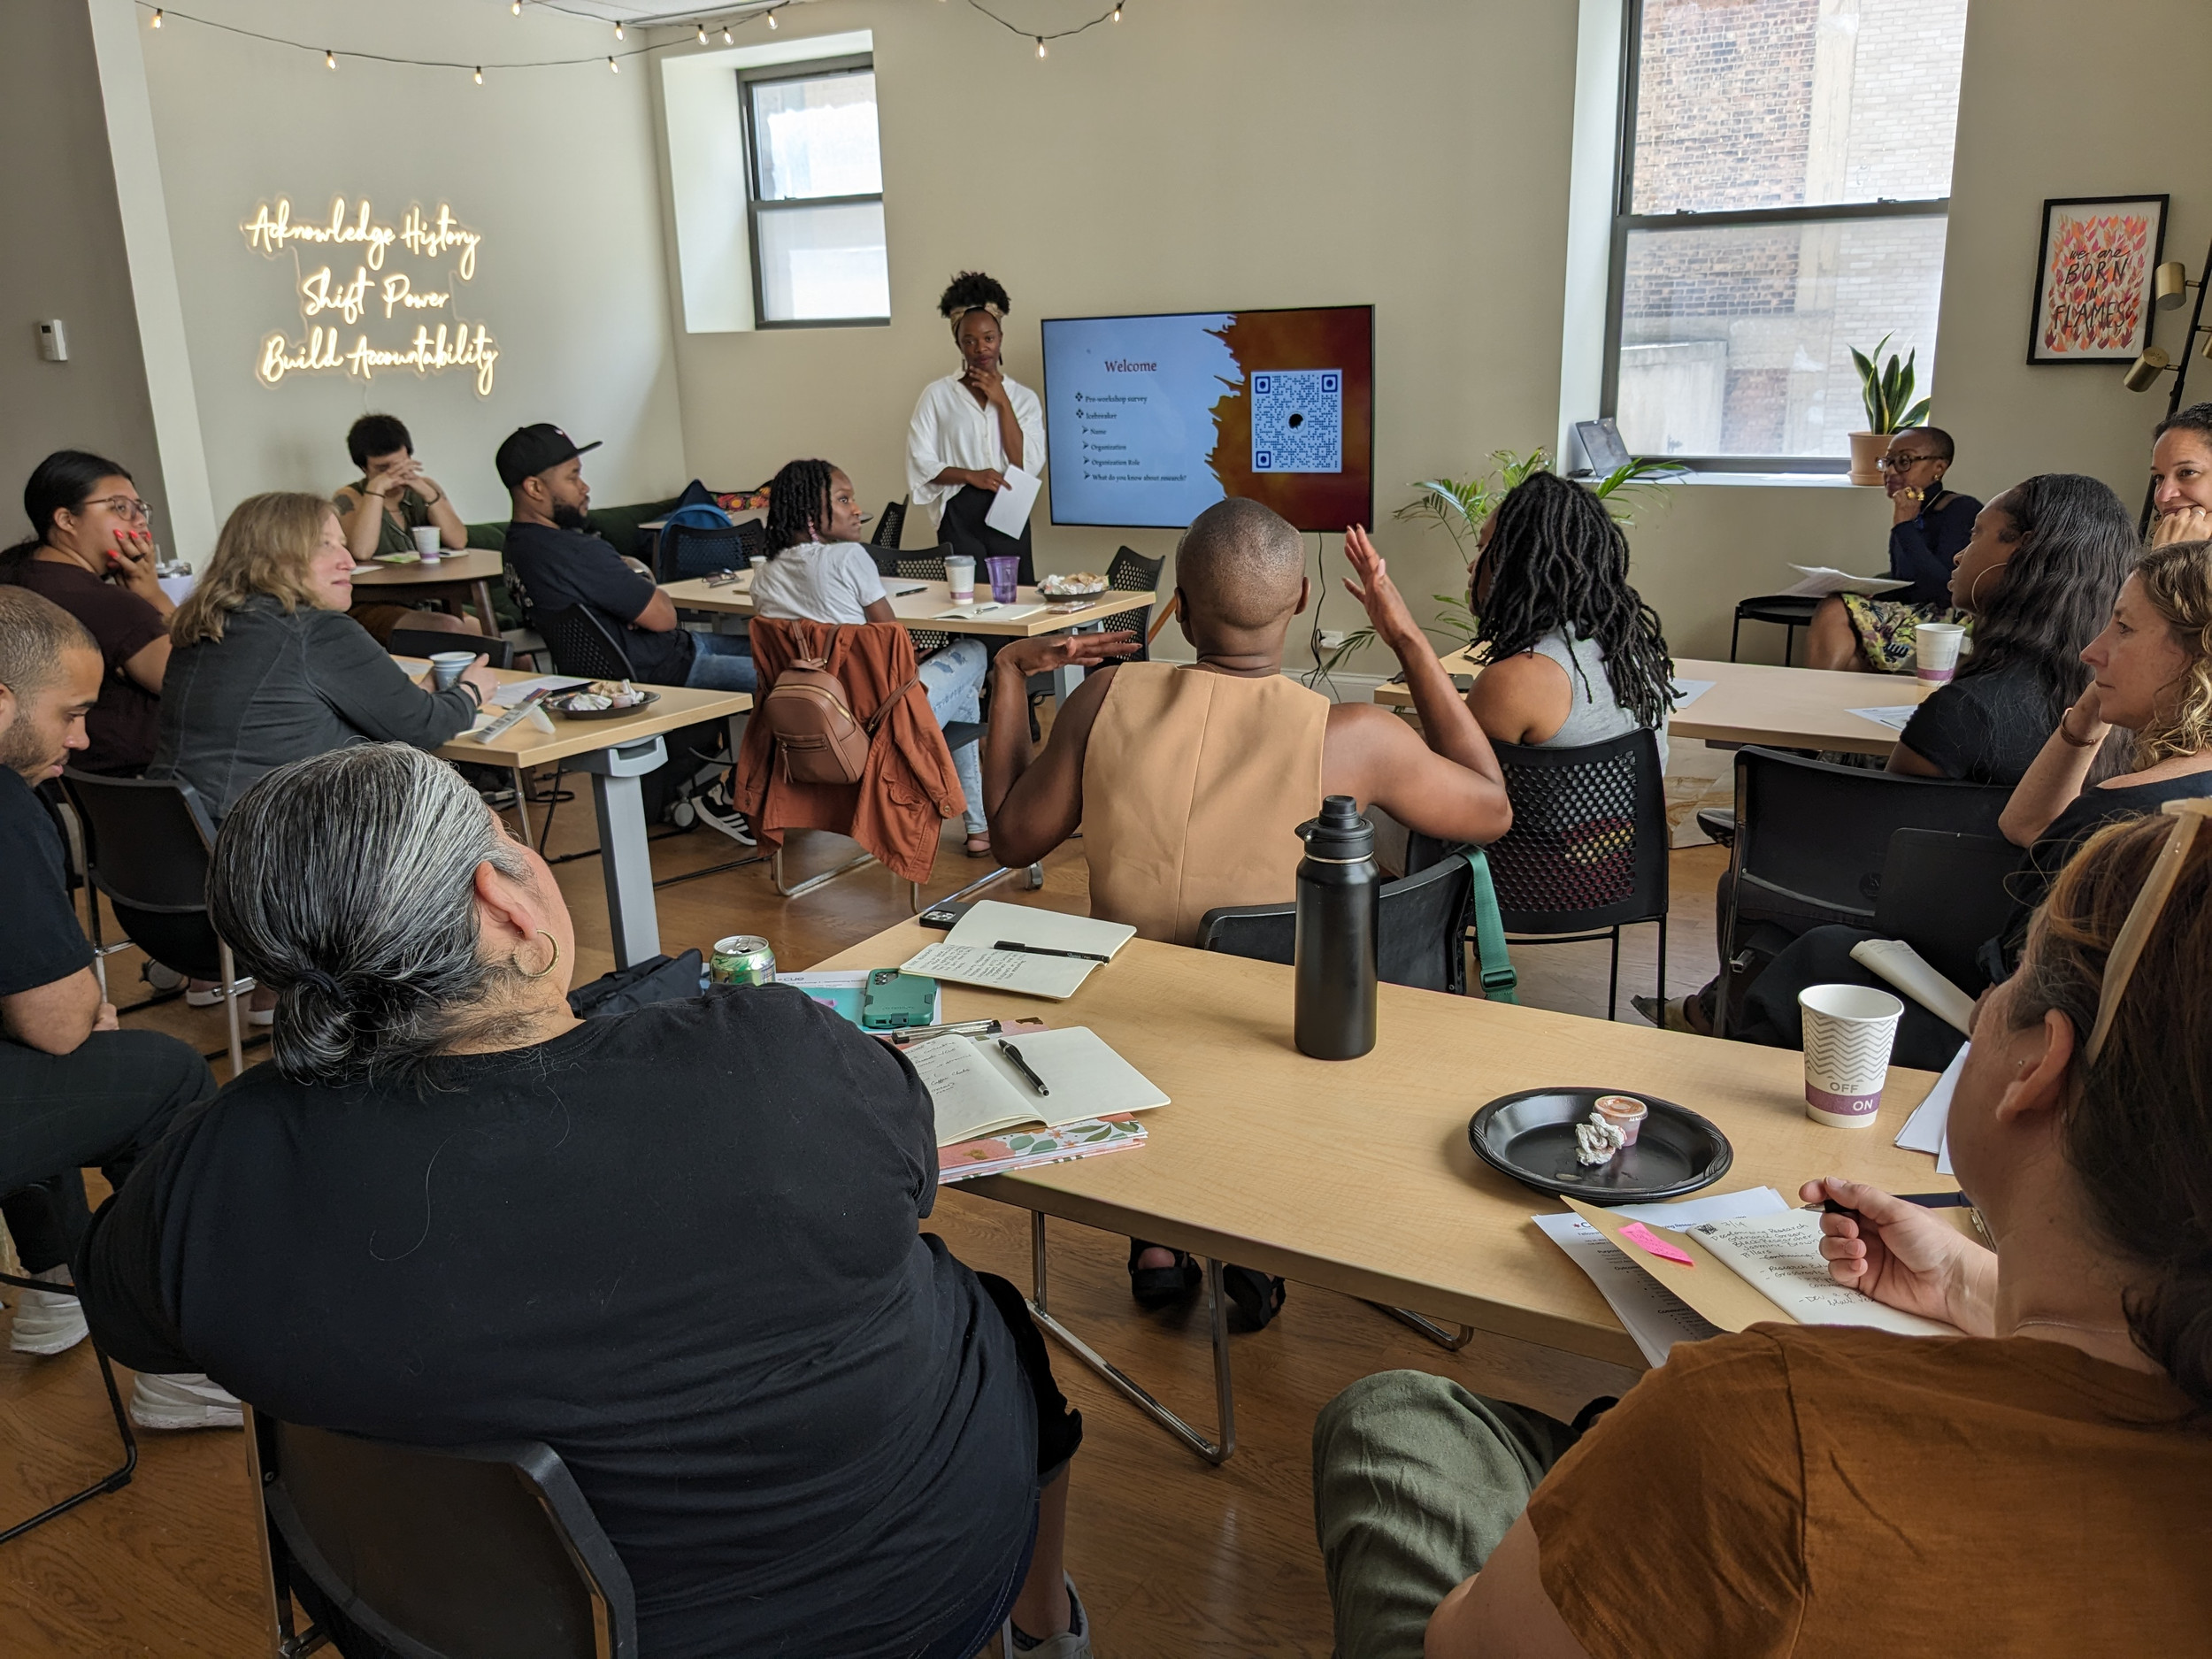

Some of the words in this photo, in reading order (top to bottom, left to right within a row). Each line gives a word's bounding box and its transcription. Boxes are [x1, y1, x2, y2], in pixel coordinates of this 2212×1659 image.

[245, 197, 396, 271] Acknowledge
[400, 204, 481, 280] History
[2070, 250, 2090, 260] we
[2097, 249, 2131, 258] are
[2065, 257, 2129, 285] BORN
[303, 265, 375, 325] Shift
[381, 273, 450, 319] Power
[2086, 287, 2098, 300] IN
[2055, 302, 2125, 330] FLAMES
[262, 325, 345, 383] Build
[346, 324, 499, 396] Accountability
[1105, 358, 1157, 373] Welcome
[1085, 395, 1126, 404] Pre-workshop
[1127, 396, 1148, 404] survey
[1090, 444, 1126, 453] Organization
[1091, 459, 1127, 468] Organization
[1830, 1082, 1860, 1094] OFF
[1853, 1099, 1874, 1111] ON
[1740, 1249, 1772, 1259] Pillars
